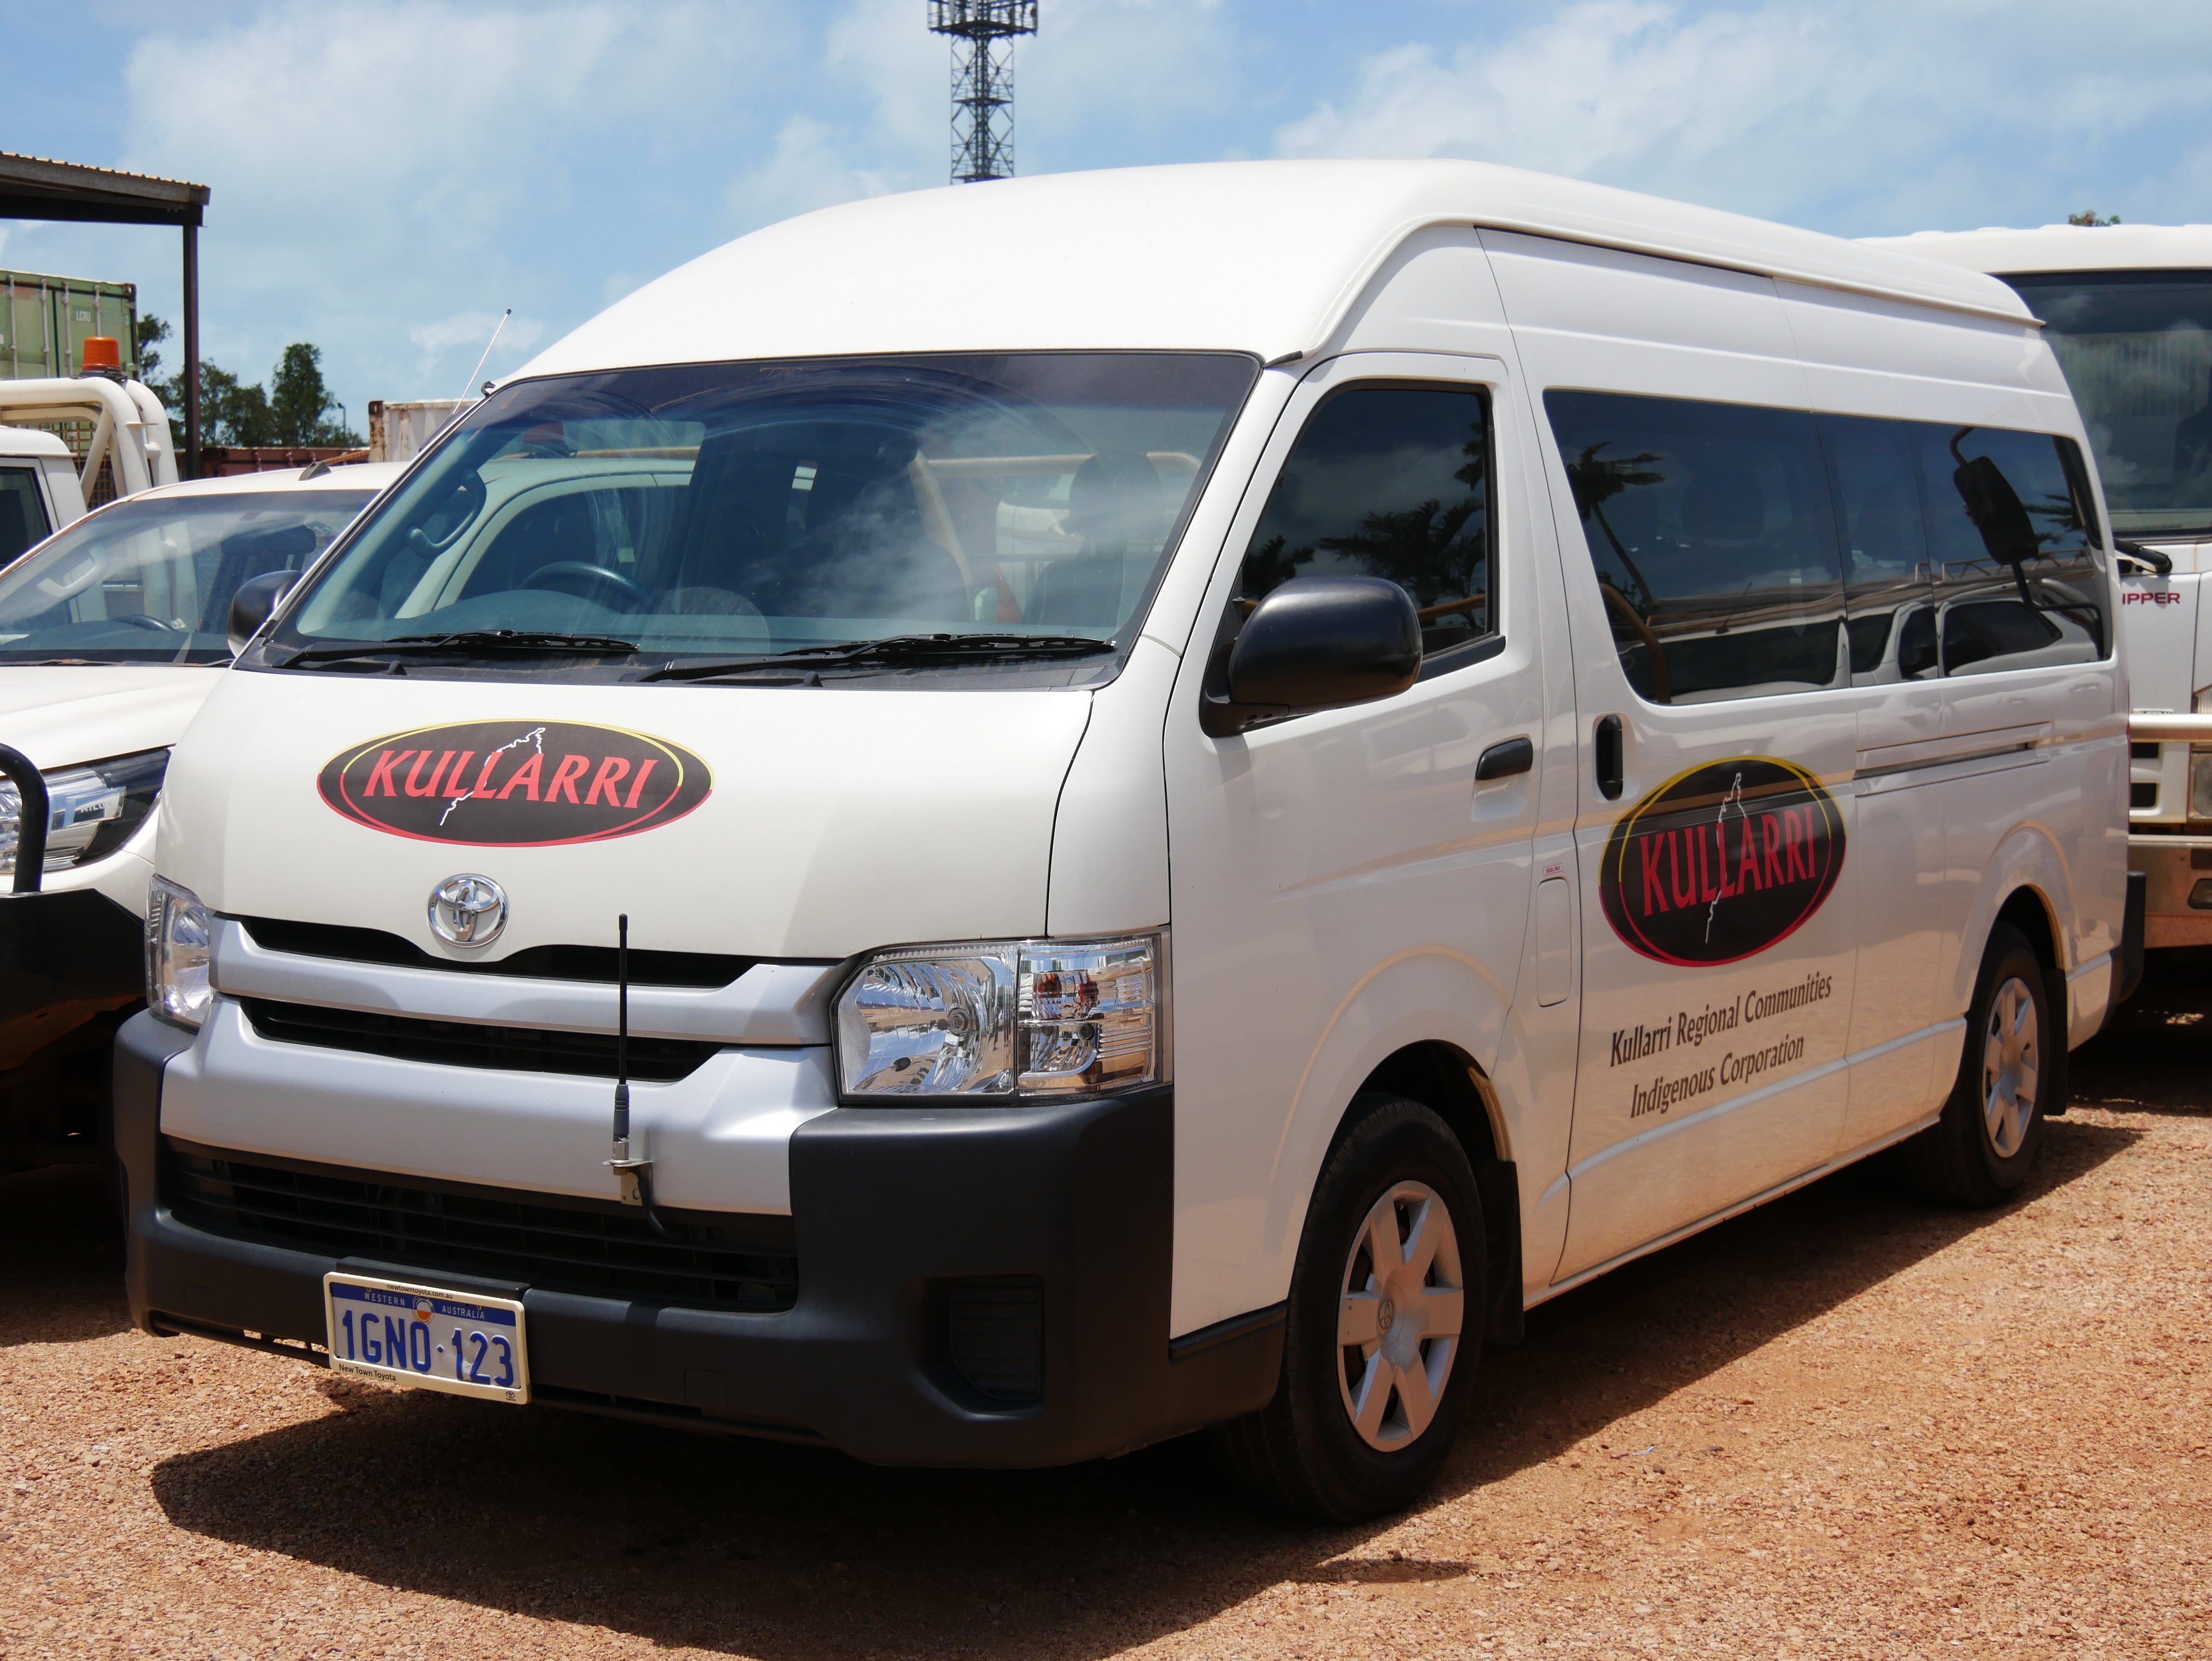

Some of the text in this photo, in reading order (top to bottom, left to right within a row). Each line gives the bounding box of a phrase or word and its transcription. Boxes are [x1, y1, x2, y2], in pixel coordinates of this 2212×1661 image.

[363, 750, 658, 809] KULLARRI
[1639, 806, 1816, 917] KULLARRI
[1610, 971, 1832, 1068] Kullarri Regional Communities
[1630, 1033, 1804, 1119] Indigenous Corporation
[365, 1292, 485, 1320] WESTERN AUSTRALIA
[387, 1283, 453, 1299] newtowntoyota.com.au
[339, 1363, 396, 1381] New Town Toyota
